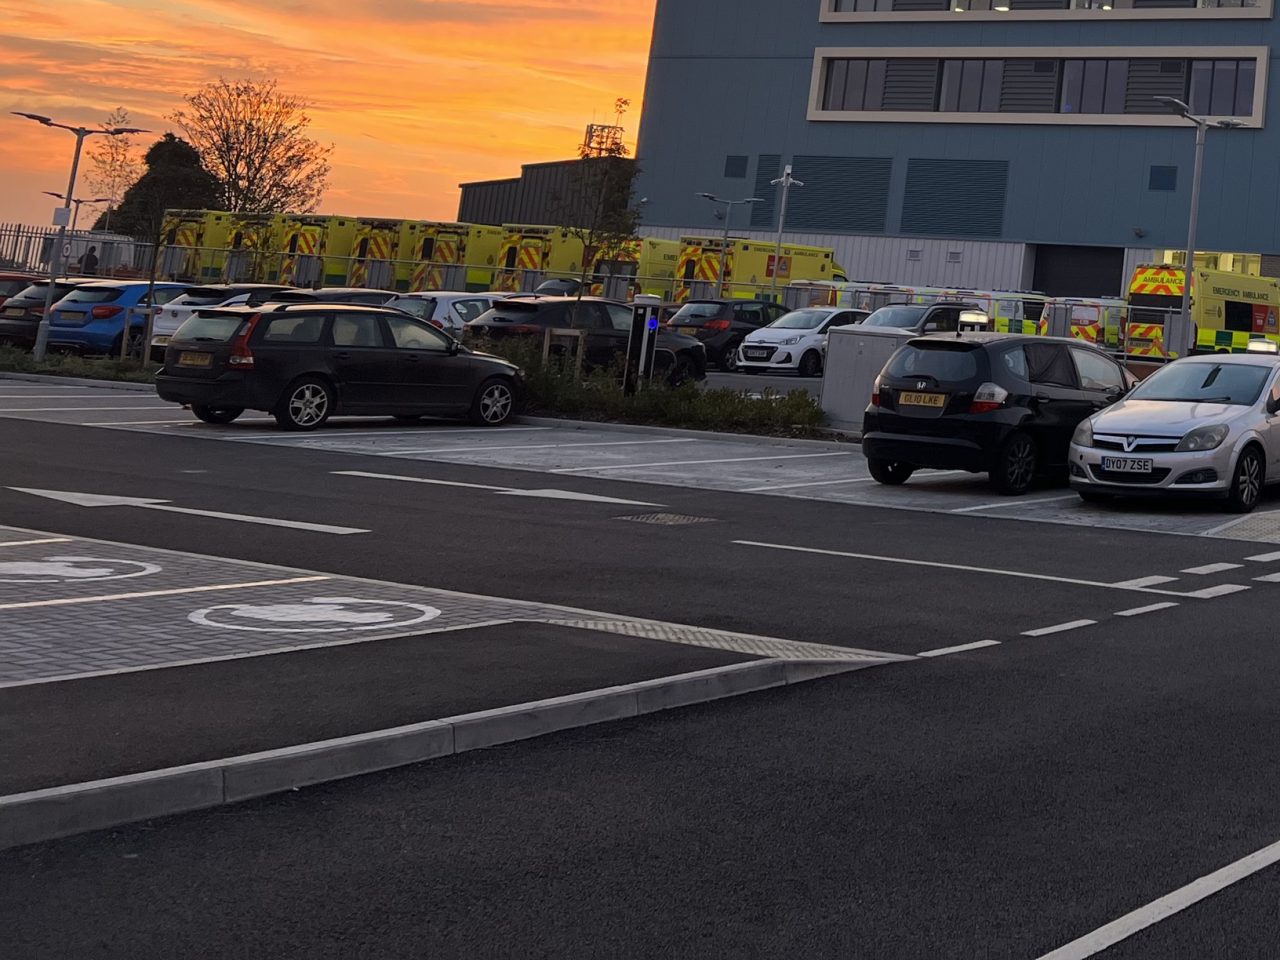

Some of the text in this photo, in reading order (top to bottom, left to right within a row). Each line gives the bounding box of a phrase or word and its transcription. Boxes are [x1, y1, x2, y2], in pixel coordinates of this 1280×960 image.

[1143, 276, 1184, 285] AMBULANCE
[1212, 286, 1269, 300] EMERGENCY AMBULANCE
[1106, 458, 1150, 471] DY07 ZSE
